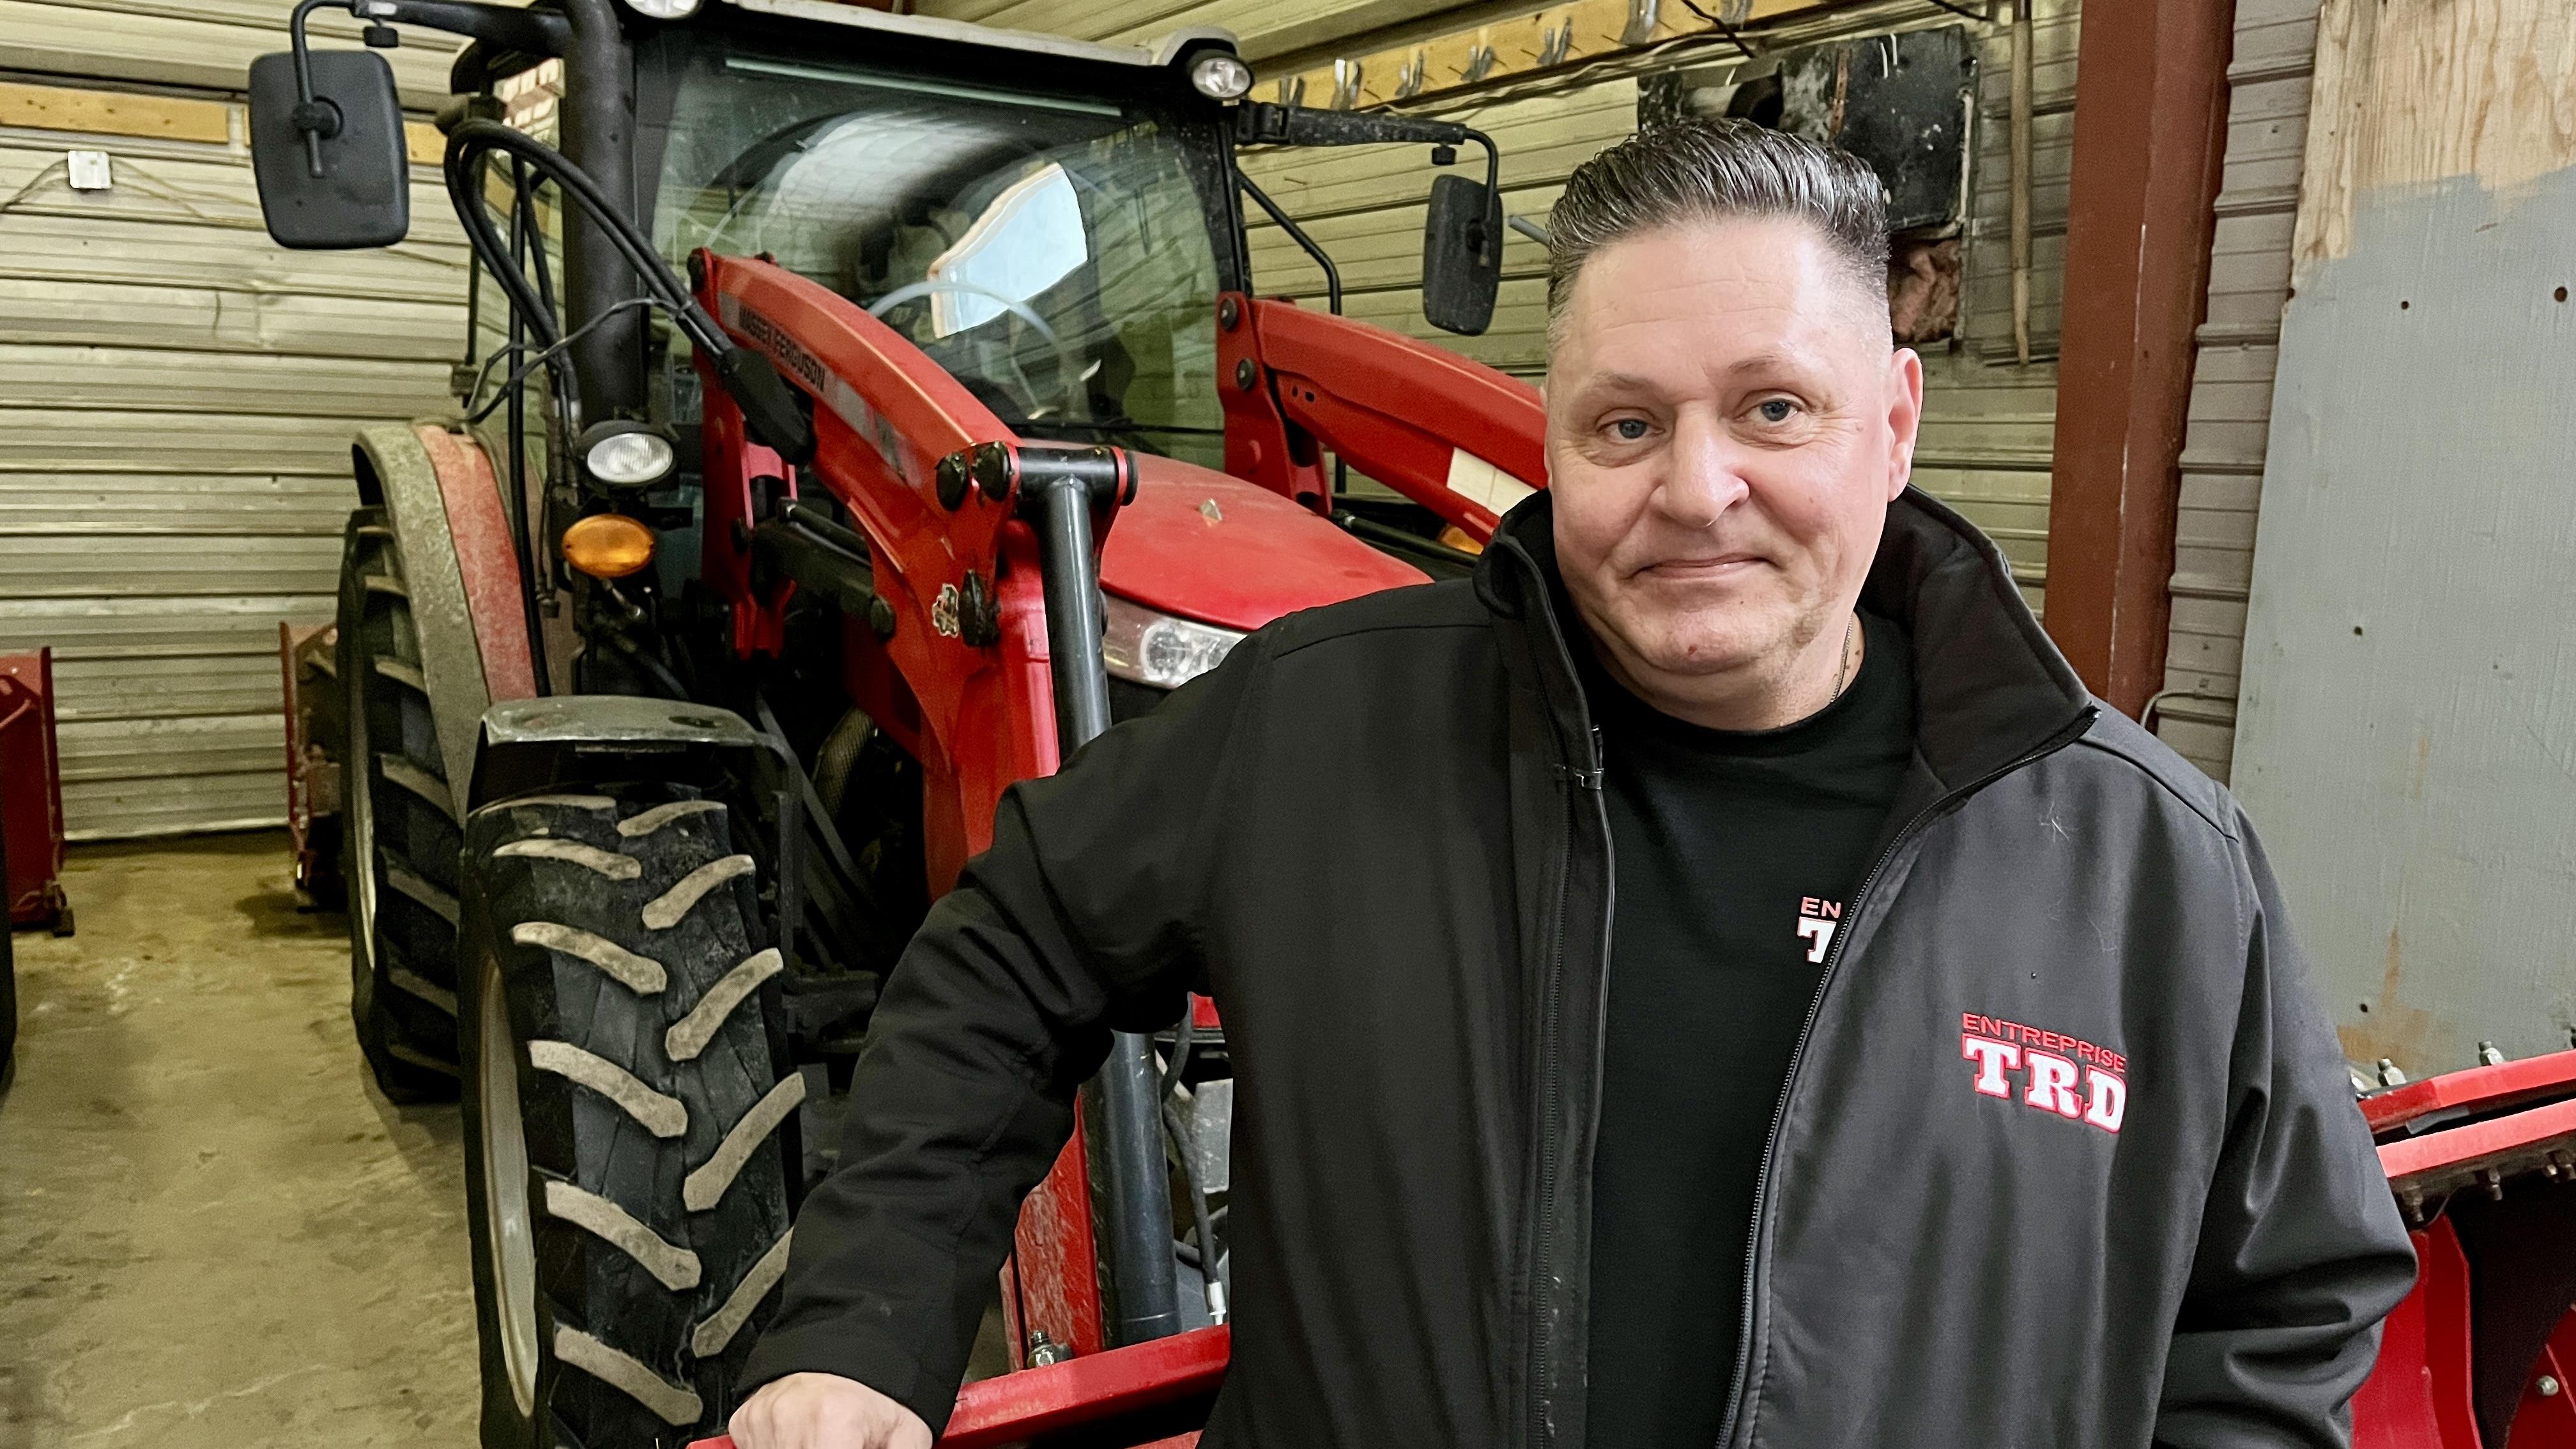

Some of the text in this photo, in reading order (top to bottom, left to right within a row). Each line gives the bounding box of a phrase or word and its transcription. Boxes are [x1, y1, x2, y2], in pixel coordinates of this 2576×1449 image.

[774, 328, 825, 393] FERGUSON
[1962, 1012, 2127, 1073] ENTREPRISE
[1961, 1032, 2127, 1133] TRD
